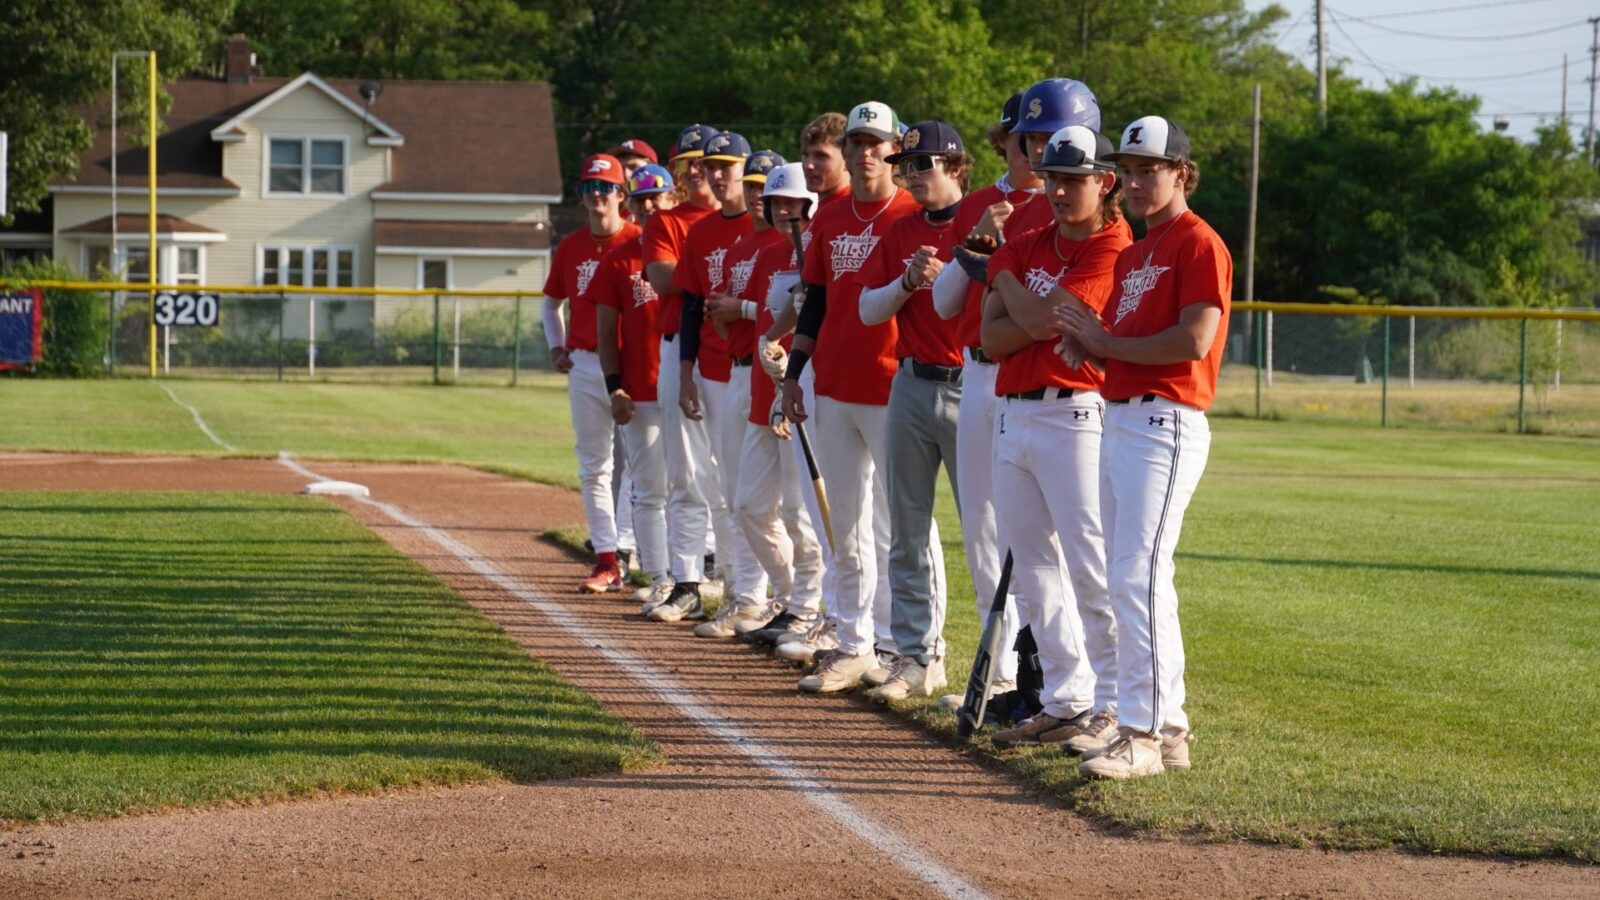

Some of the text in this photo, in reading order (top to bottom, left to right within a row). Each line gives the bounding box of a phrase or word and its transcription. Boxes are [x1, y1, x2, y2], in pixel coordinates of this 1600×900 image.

[858, 107, 878, 122] RP
[1026, 98, 1043, 119] S
[1126, 126, 1143, 145] L
[588, 159, 612, 173] P
[155, 294, 217, 325] 320
